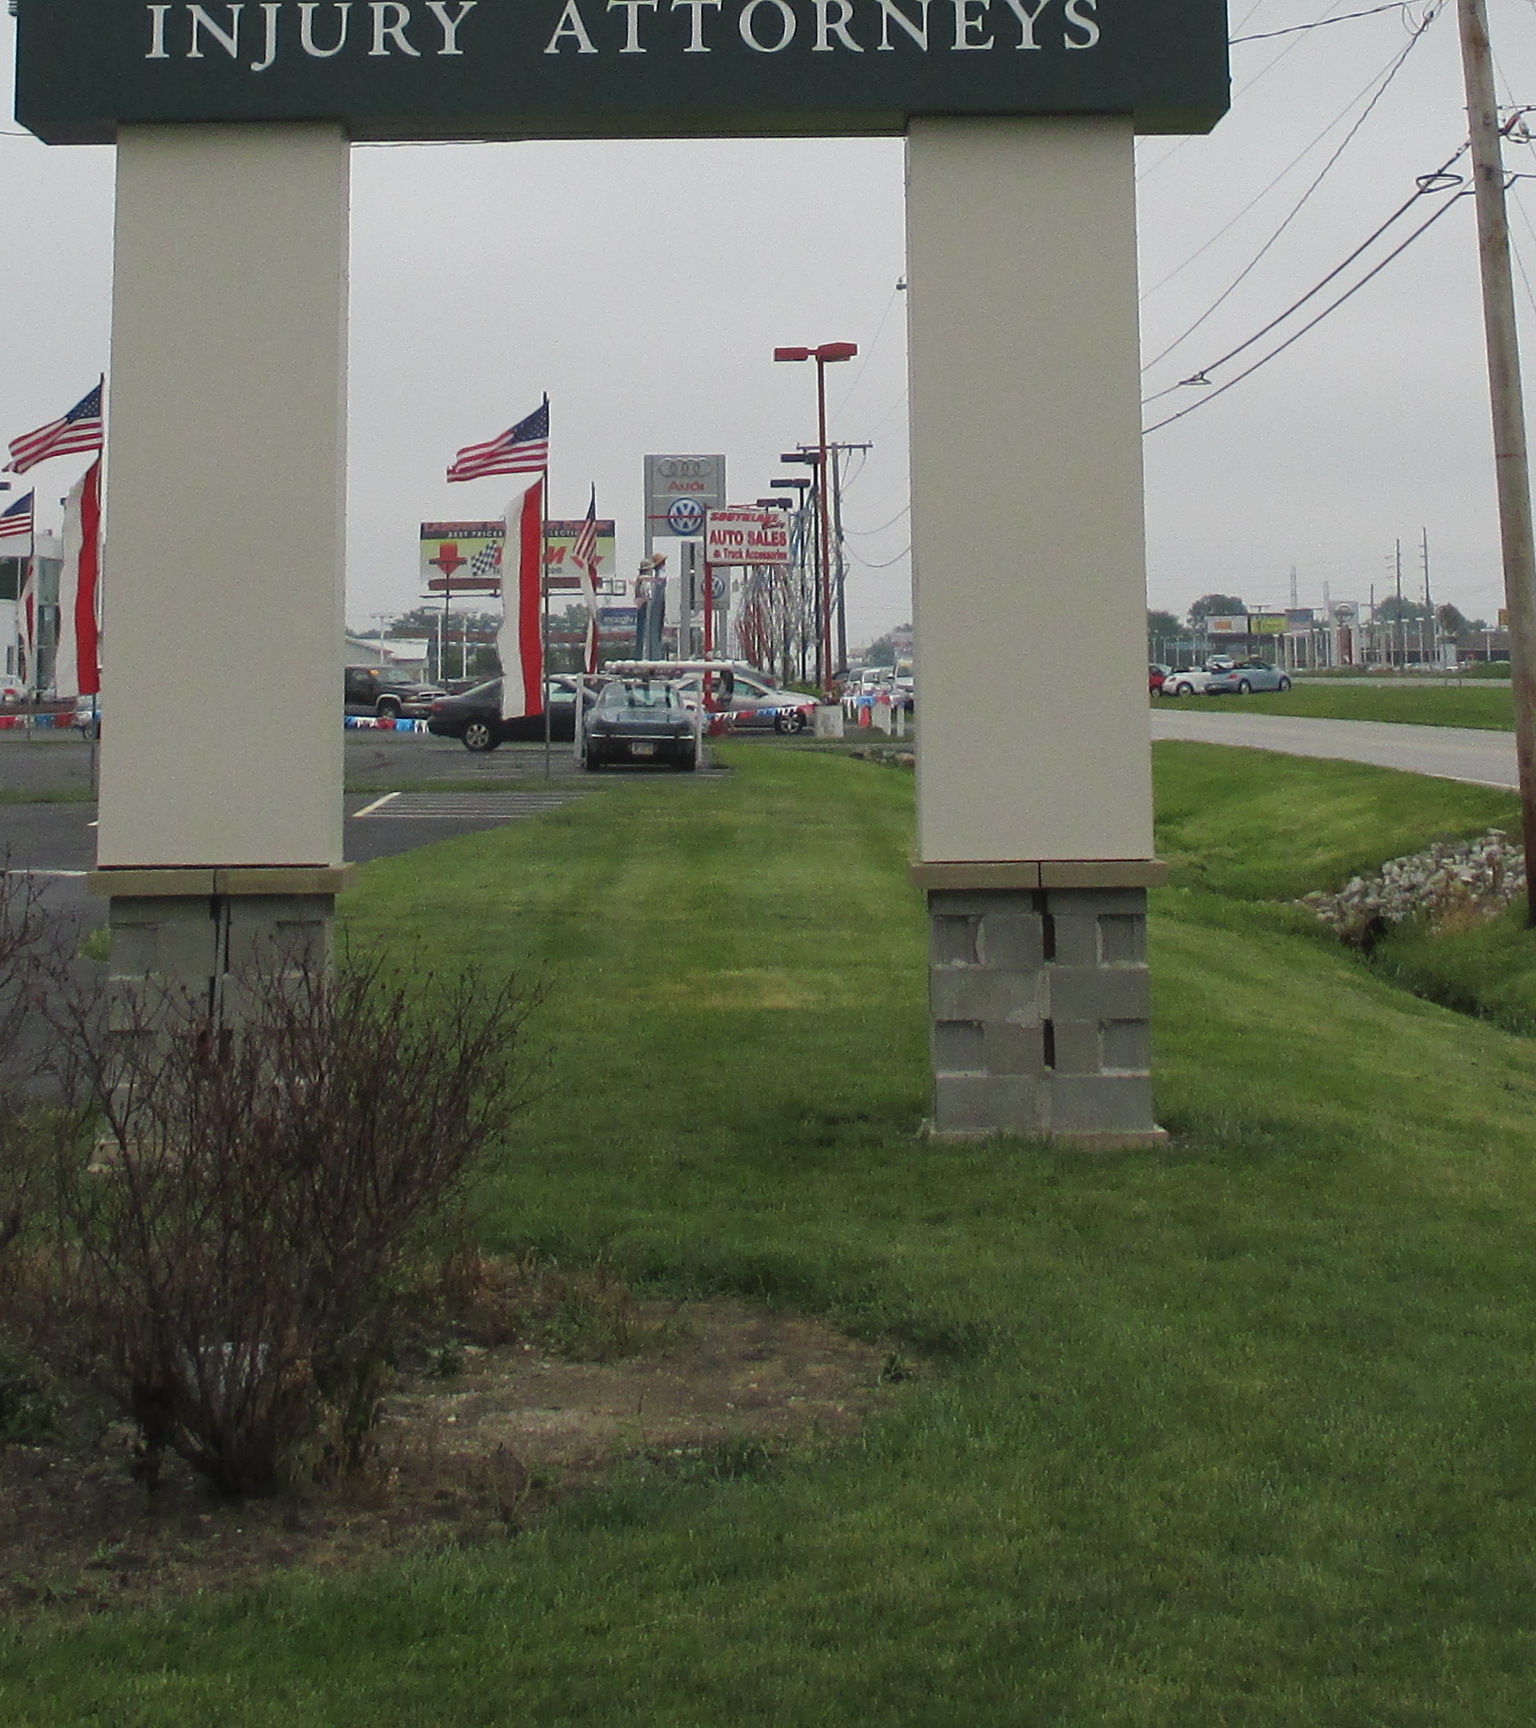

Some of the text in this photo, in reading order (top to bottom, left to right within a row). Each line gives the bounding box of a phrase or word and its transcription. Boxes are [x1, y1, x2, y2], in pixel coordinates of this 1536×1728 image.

[145, 1, 478, 72] INJURY
[709, 529, 787, 546] AUTO SALES
